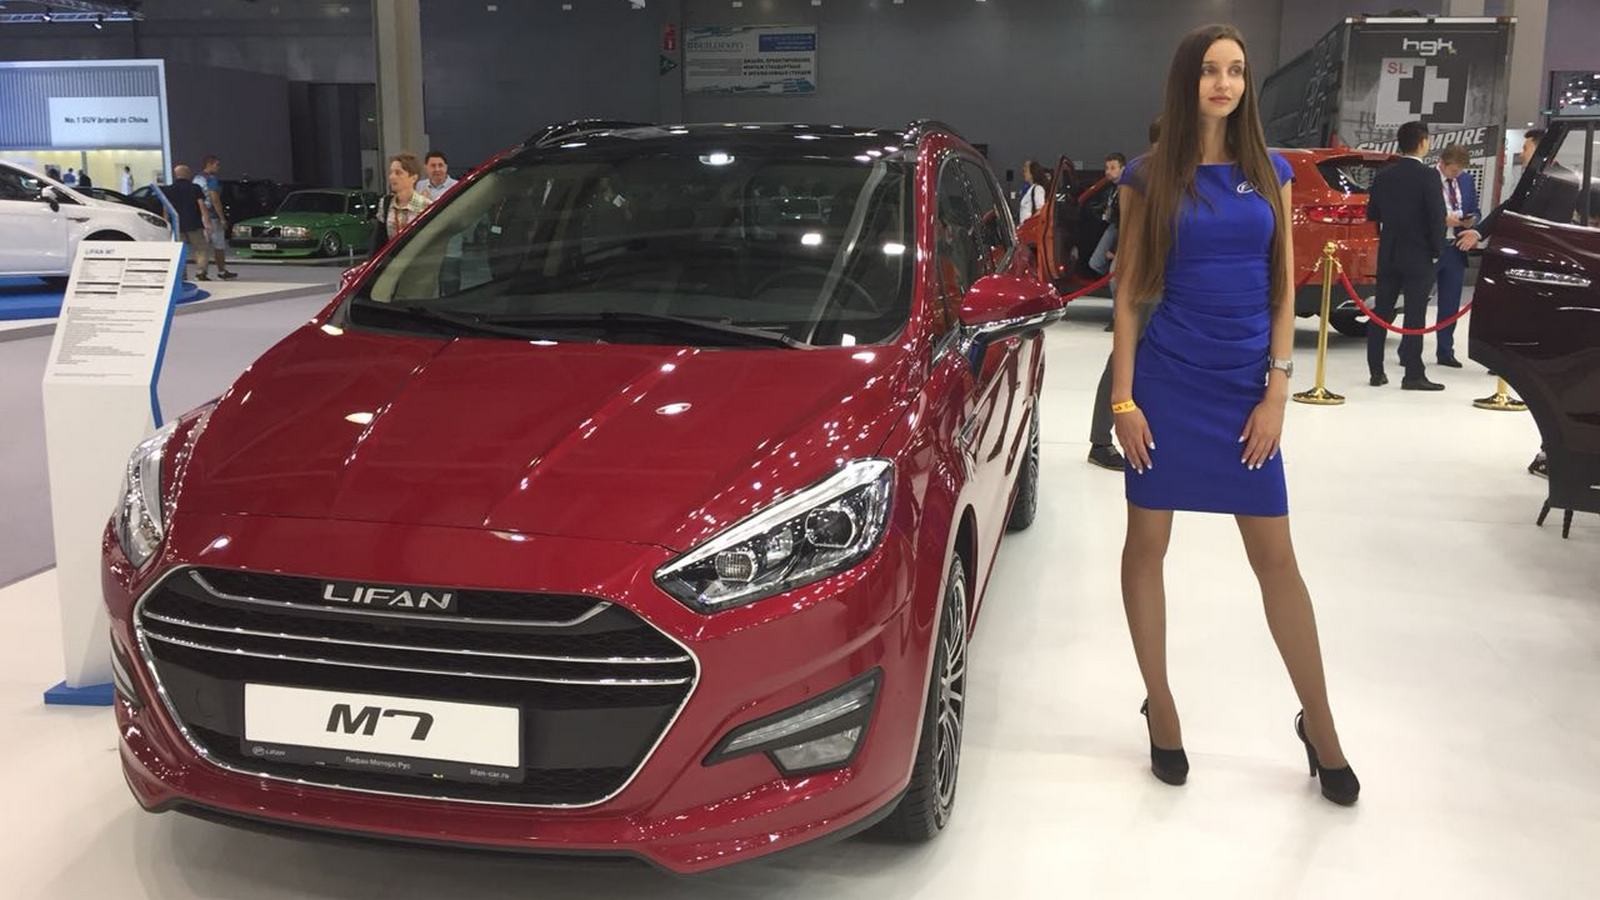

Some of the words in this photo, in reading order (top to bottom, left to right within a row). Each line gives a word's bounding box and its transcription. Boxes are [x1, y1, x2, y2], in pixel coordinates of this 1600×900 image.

[1387, 62, 1408, 75] SL
[81, 116, 96, 124] SUV
[97, 116, 118, 124] brand
[119, 116, 127, 124] in
[128, 116, 149, 124] China
[1429, 126, 1488, 151] MPIRE
[322, 583, 452, 610] LIFAN
[325, 703, 435, 741] M7
